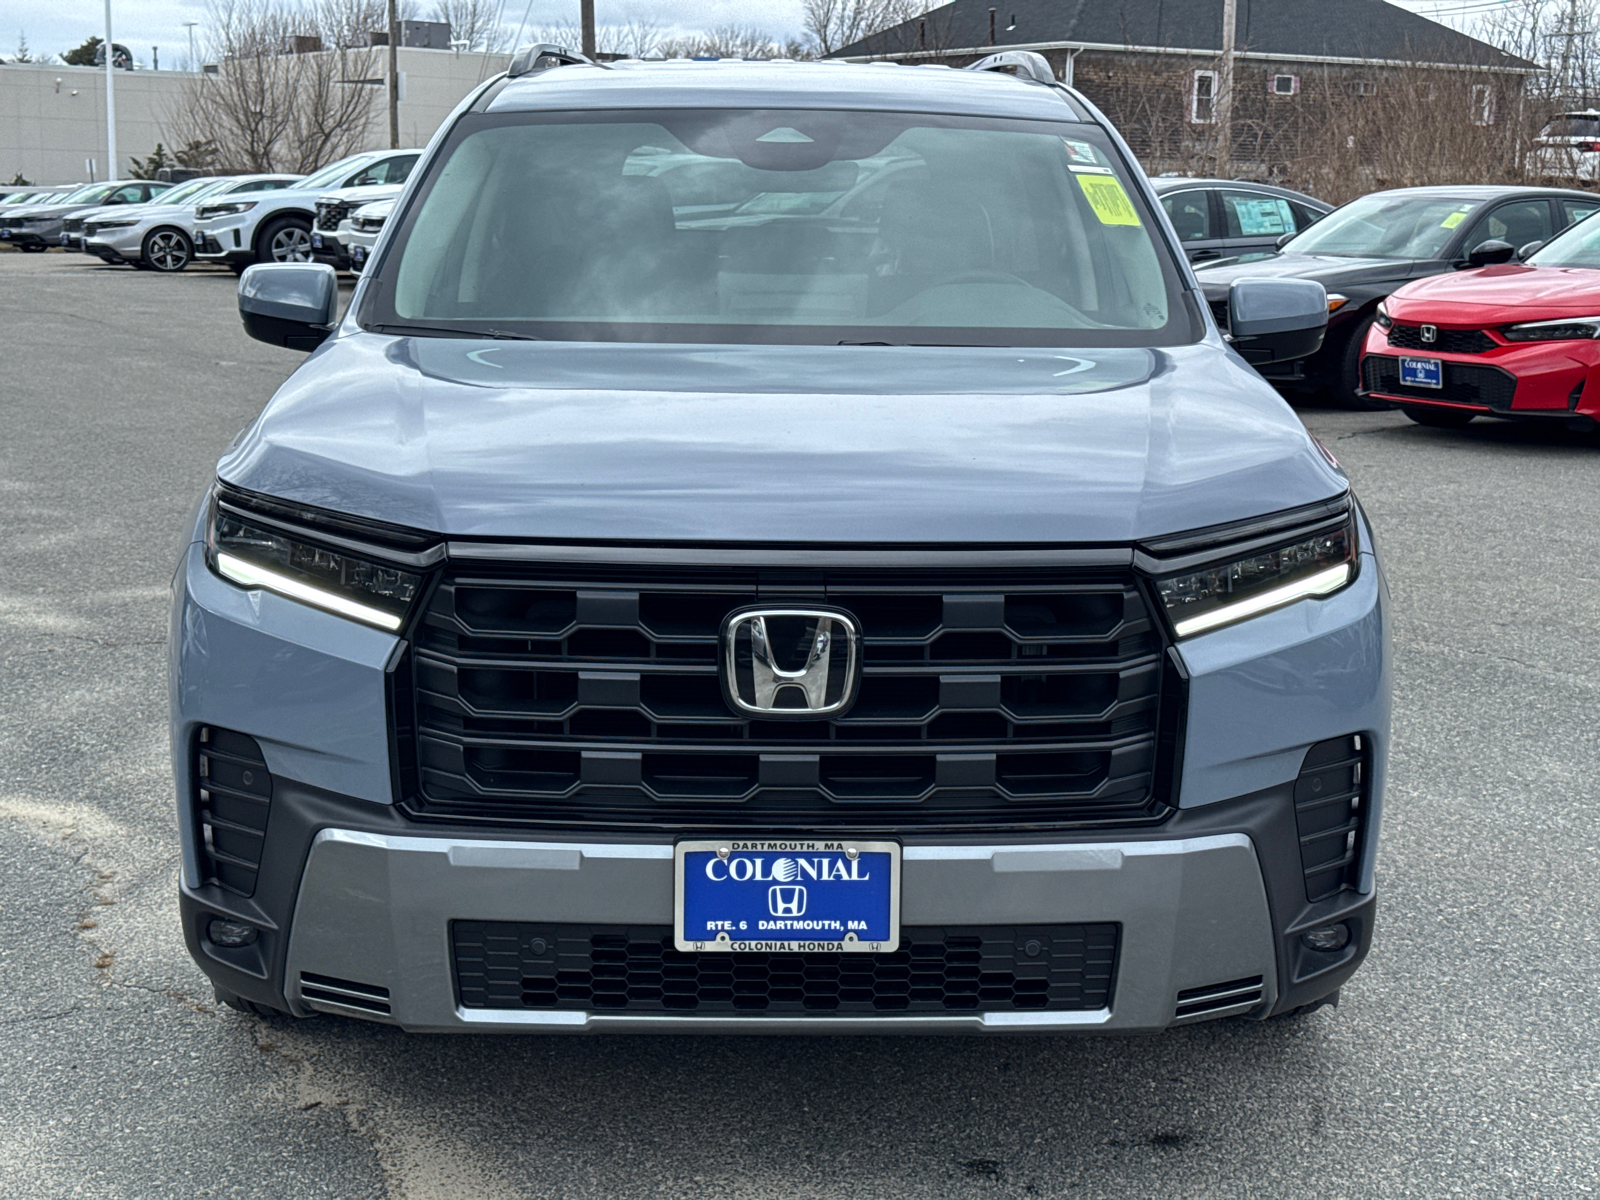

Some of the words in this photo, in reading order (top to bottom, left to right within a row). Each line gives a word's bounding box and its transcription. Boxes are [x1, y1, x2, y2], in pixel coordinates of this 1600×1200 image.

[732, 842, 820, 851] DARTMOUTH,
[824, 842, 844, 851] MA
[705, 857, 870, 882] COLONIAL
[706, 920, 736, 931] RTE.
[739, 920, 748, 931] 6
[758, 920, 844, 931] DARTMOUTH,
[847, 920, 868, 931] MA
[730, 941, 794, 952] COLONIAL
[797, 941, 844, 952] HONDA
